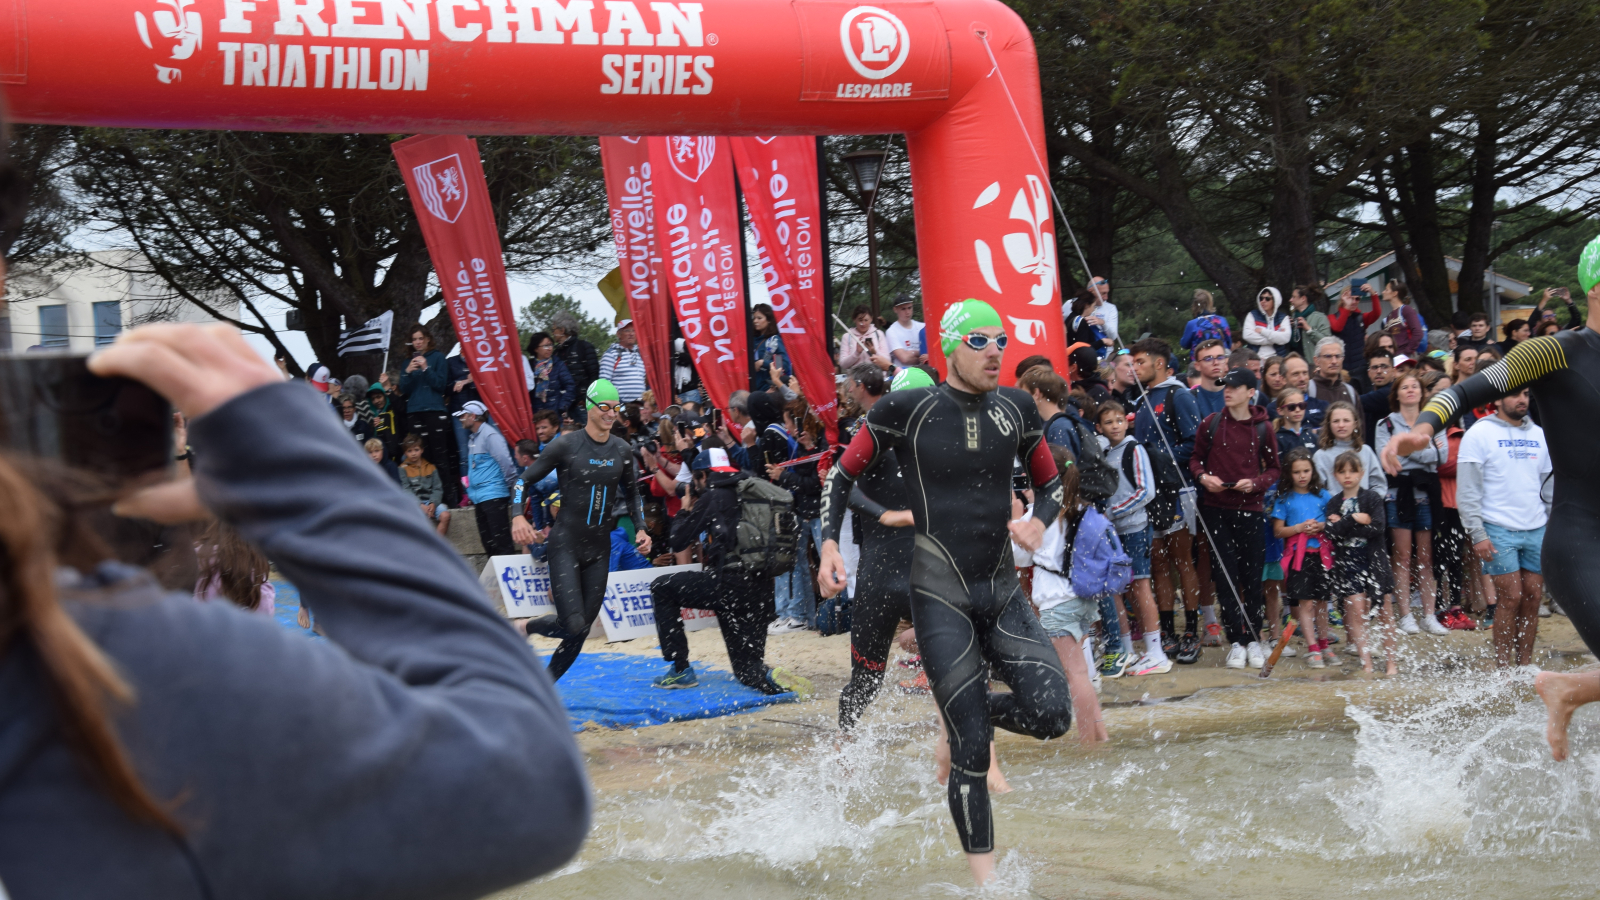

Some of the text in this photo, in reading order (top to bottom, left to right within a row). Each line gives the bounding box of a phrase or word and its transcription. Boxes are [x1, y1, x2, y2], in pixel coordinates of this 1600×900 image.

[219, 0, 704, 47] FRENCHMAN
[218, 42, 430, 91] TRIATHLON
[600, 53, 714, 95] SERIES
[836, 82, 912, 98] LESPARRE
[453, 299, 471, 343] RÉGION
[457, 261, 498, 373] Nouvelle-
[966, 416, 978, 449] HUUB
[523, 578, 551, 593] FRE
[615, 581, 652, 594] E.Lecle
[620, 594, 654, 612] FRE
[626, 611, 656, 627] TRIATH
